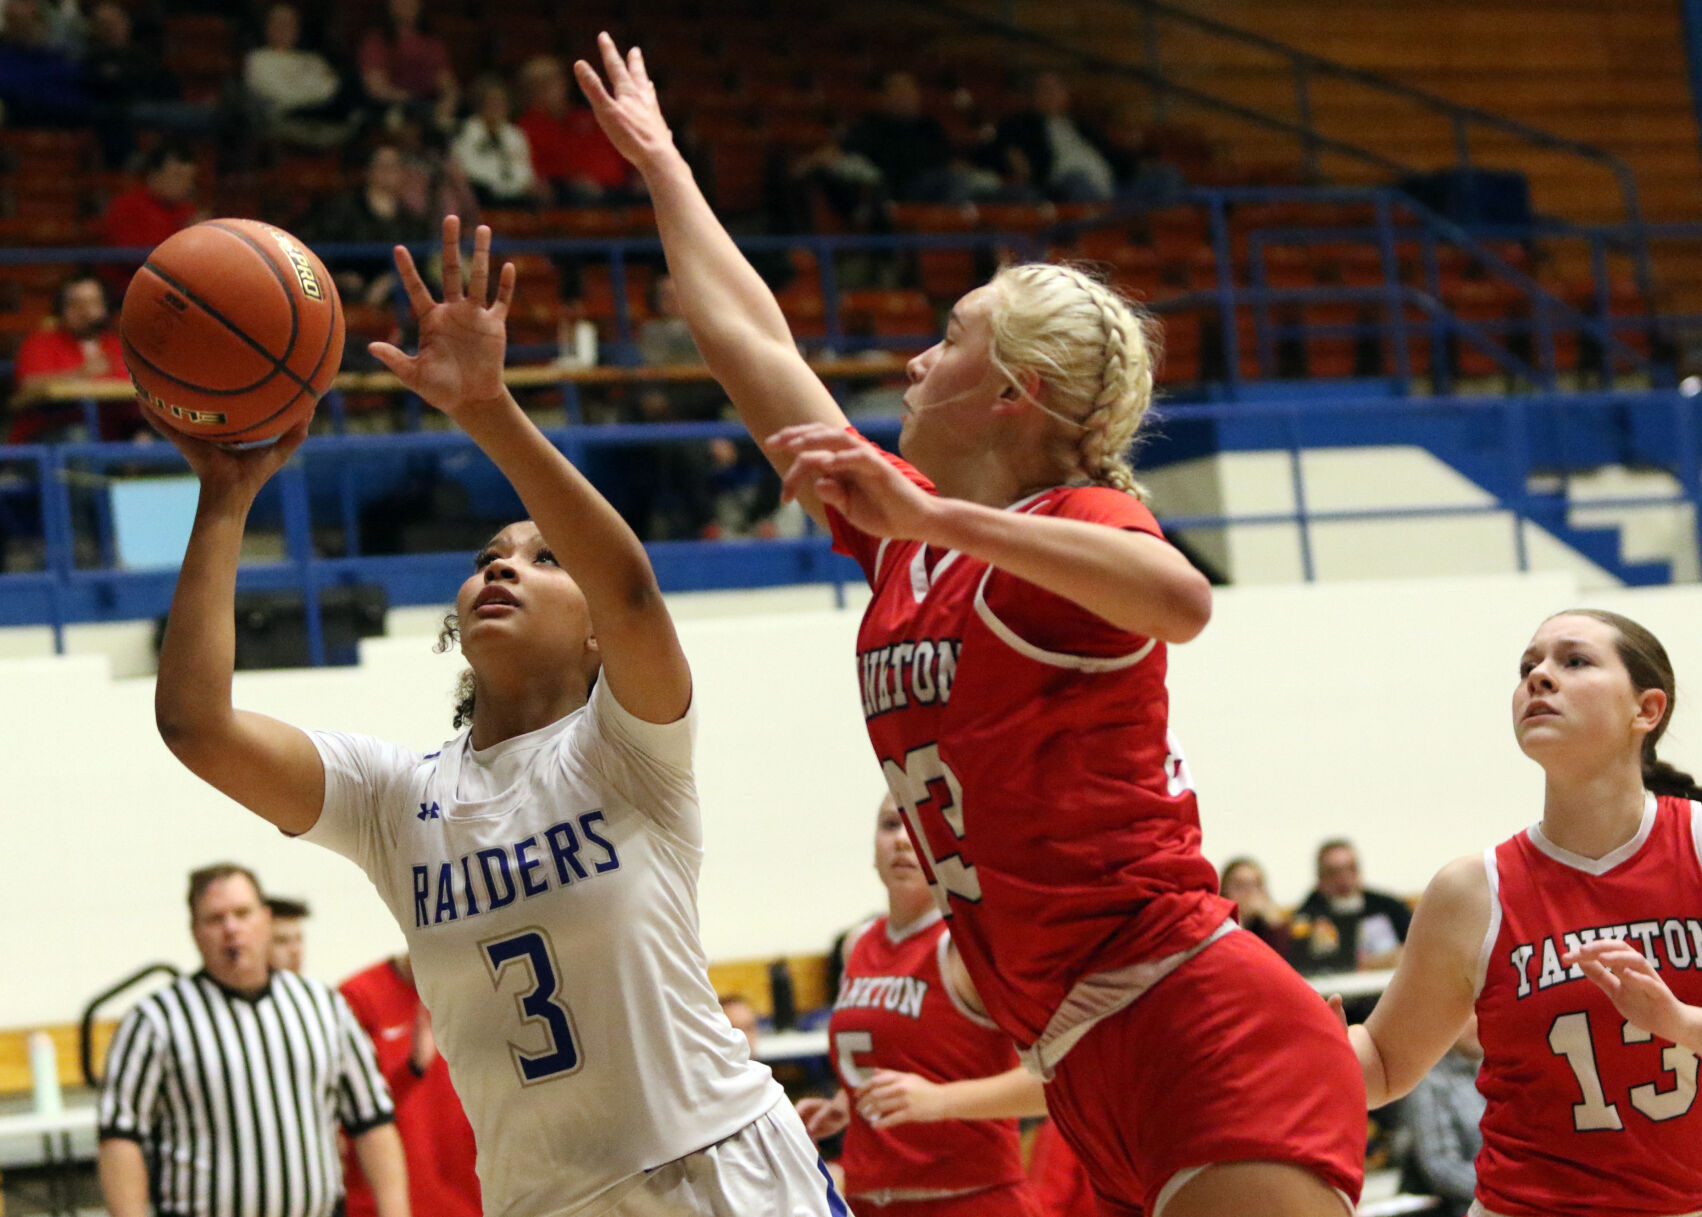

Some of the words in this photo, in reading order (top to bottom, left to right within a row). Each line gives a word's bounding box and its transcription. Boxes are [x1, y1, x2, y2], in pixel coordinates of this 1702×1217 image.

[857, 637, 962, 720] NKTON
[411, 808, 621, 930] RAIDERS
[476, 924, 586, 1088] 3
[1510, 917, 1702, 1000] YANTO
[1547, 1010, 1701, 1132] 13
